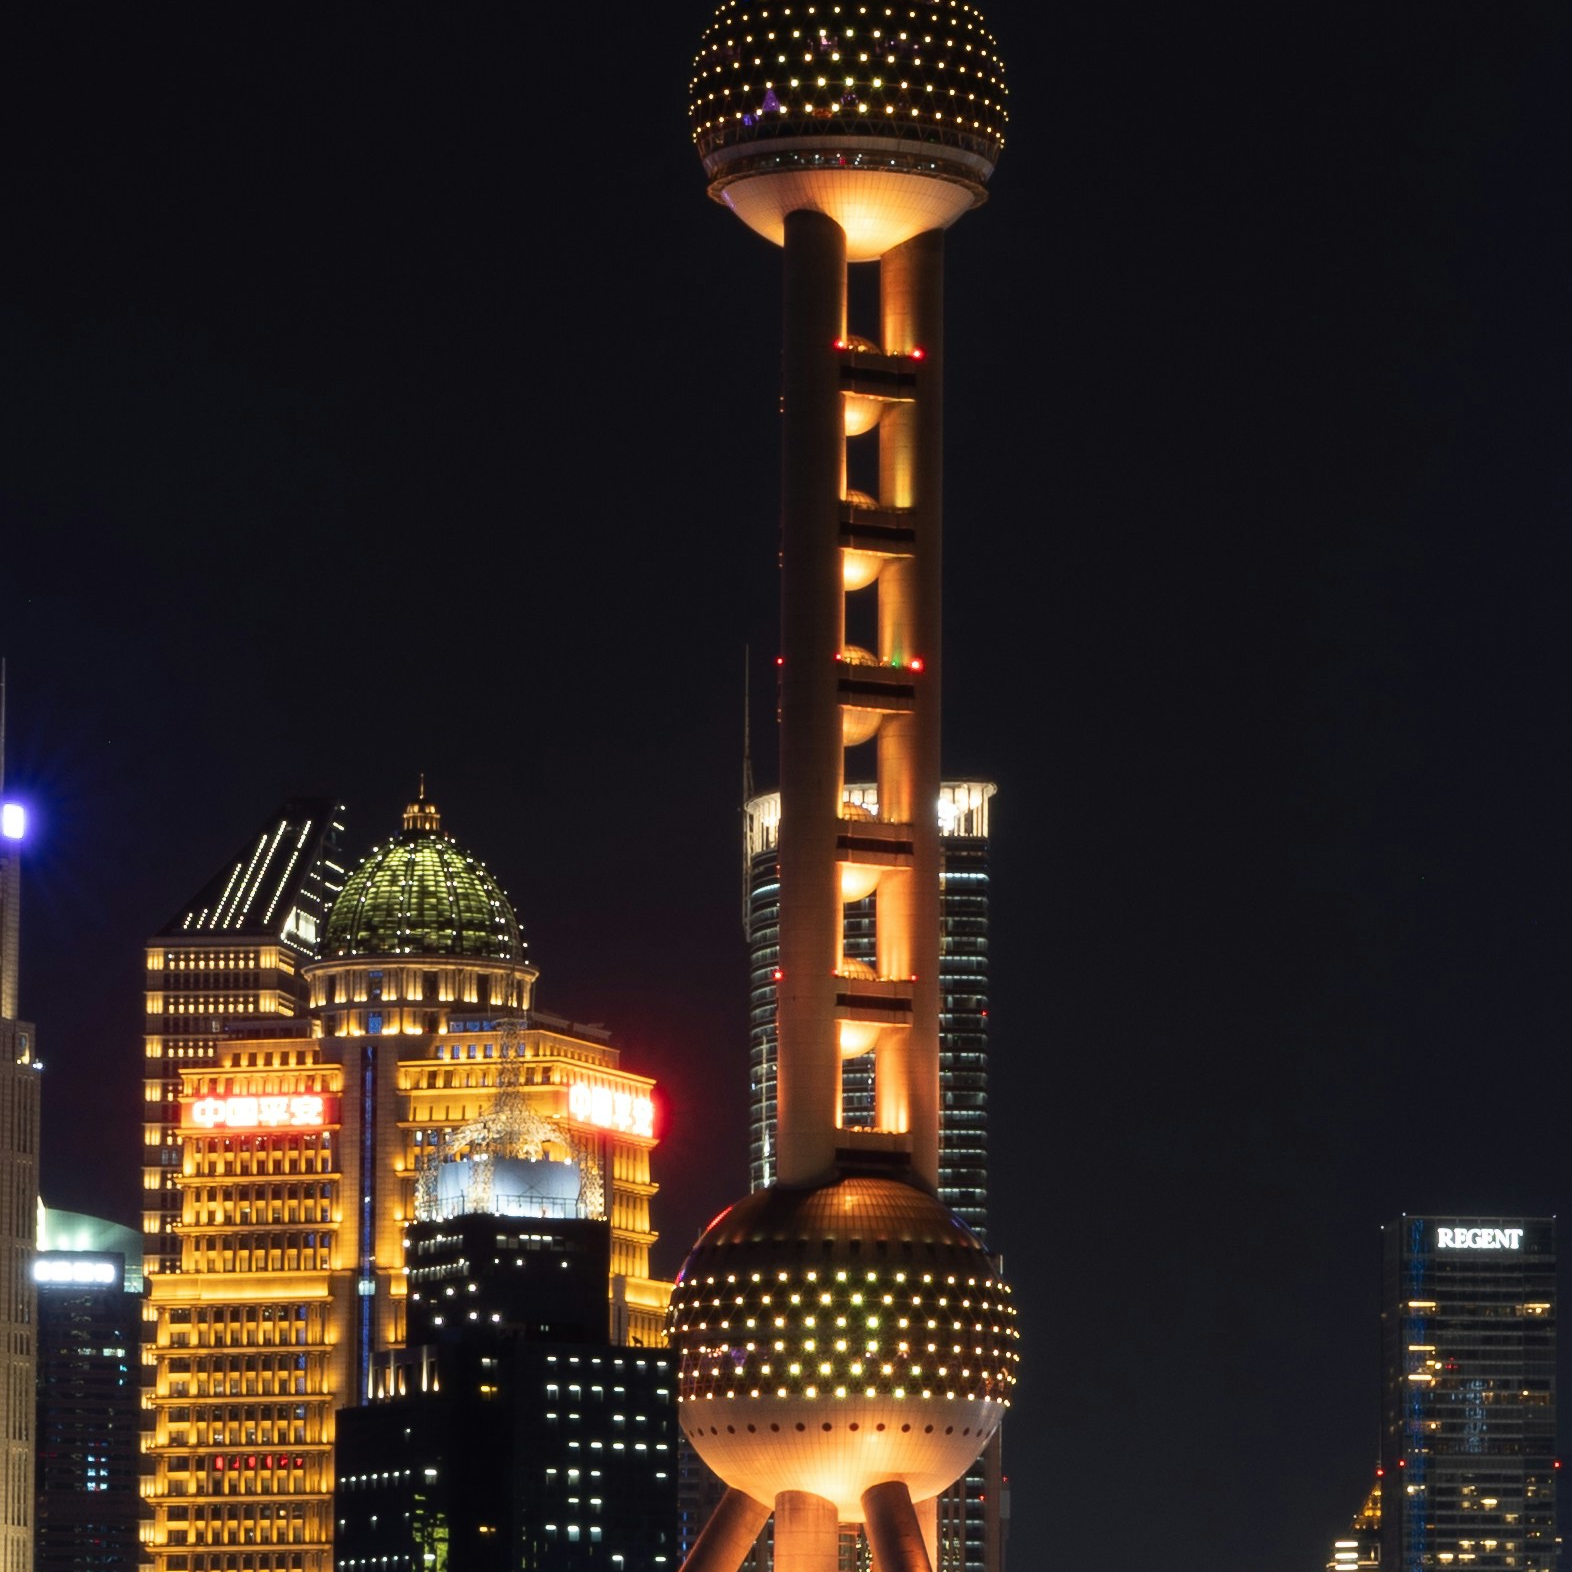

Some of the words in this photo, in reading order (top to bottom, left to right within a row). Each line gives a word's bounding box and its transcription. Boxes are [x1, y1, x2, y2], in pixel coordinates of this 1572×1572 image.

[193, 1096, 323, 1128] 中国平安
[1437, 1227, 1524, 1249] REGENT
